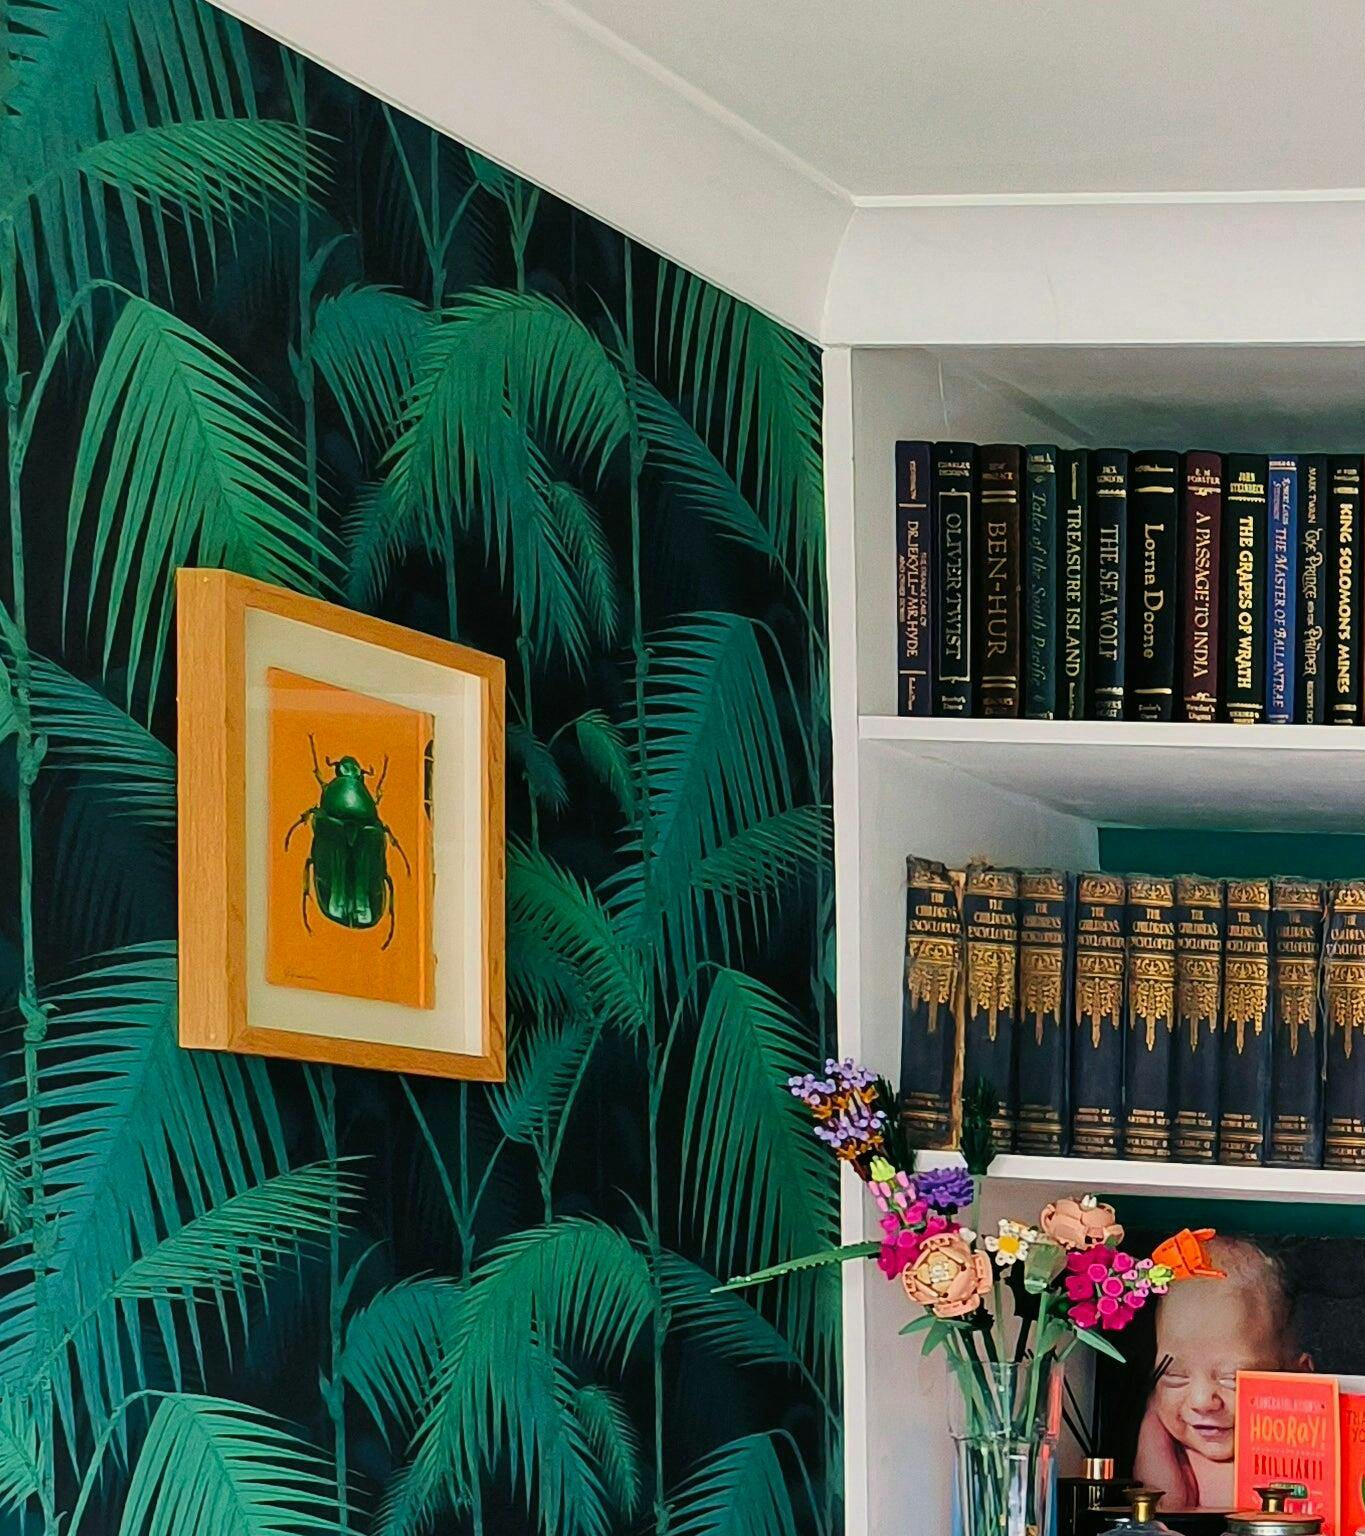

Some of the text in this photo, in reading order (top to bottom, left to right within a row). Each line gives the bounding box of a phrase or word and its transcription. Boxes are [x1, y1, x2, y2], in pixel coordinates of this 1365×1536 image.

[945, 513, 962, 659] OLIVER TWIST
[987, 522, 1008, 658] BEN-HUR
[1065, 505, 1081, 677] TREASURE ISLAND
[1099, 525, 1118, 661] THE SEA WOLF
[1143, 523, 1164, 660] Lorna Doone
[1193, 511, 1211, 678] A PASSAGE TO INDIA
[1237, 516, 1254, 689] THE GRAPES OF WRATH
[1271, 528, 1288, 708] THE MASTER OF BALLANTRAE
[1338, 503, 1353, 693] KING SOLOMON'S MINES
